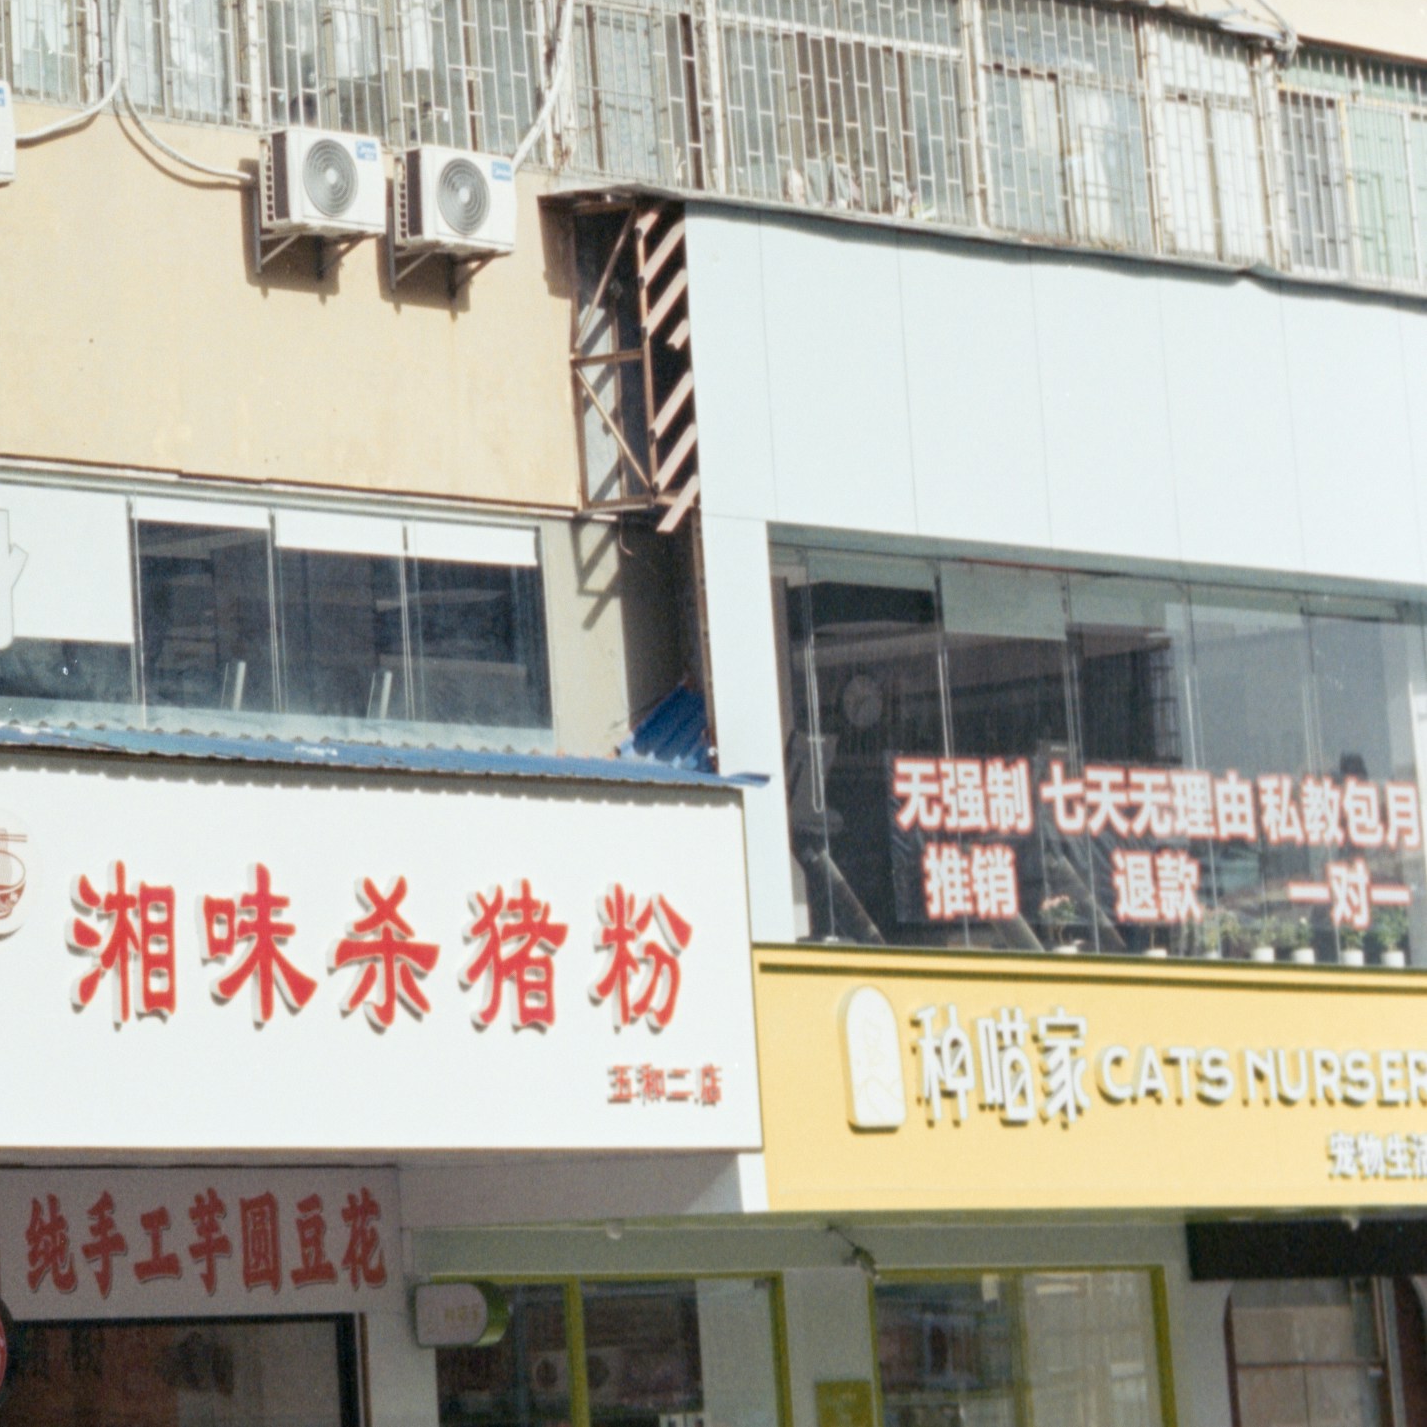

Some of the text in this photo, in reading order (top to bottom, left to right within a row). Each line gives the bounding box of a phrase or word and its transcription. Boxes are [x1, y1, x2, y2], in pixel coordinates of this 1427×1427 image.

[894, 757, 1032, 834] 无强制
[1040, 760, 1256, 842] 七天无理由
[1257, 773, 1423, 848] 私教包月
[923, 845, 1019, 920] 推销
[1112, 848, 1203, 923] 退款
[1287, 856, 1412, 929] 一对一
[69, 859, 694, 1029] 湘味杀猪粉
[609, 1063, 722, 1104] 五和二店
[1098, 1046, 1235, 1103] CATS
